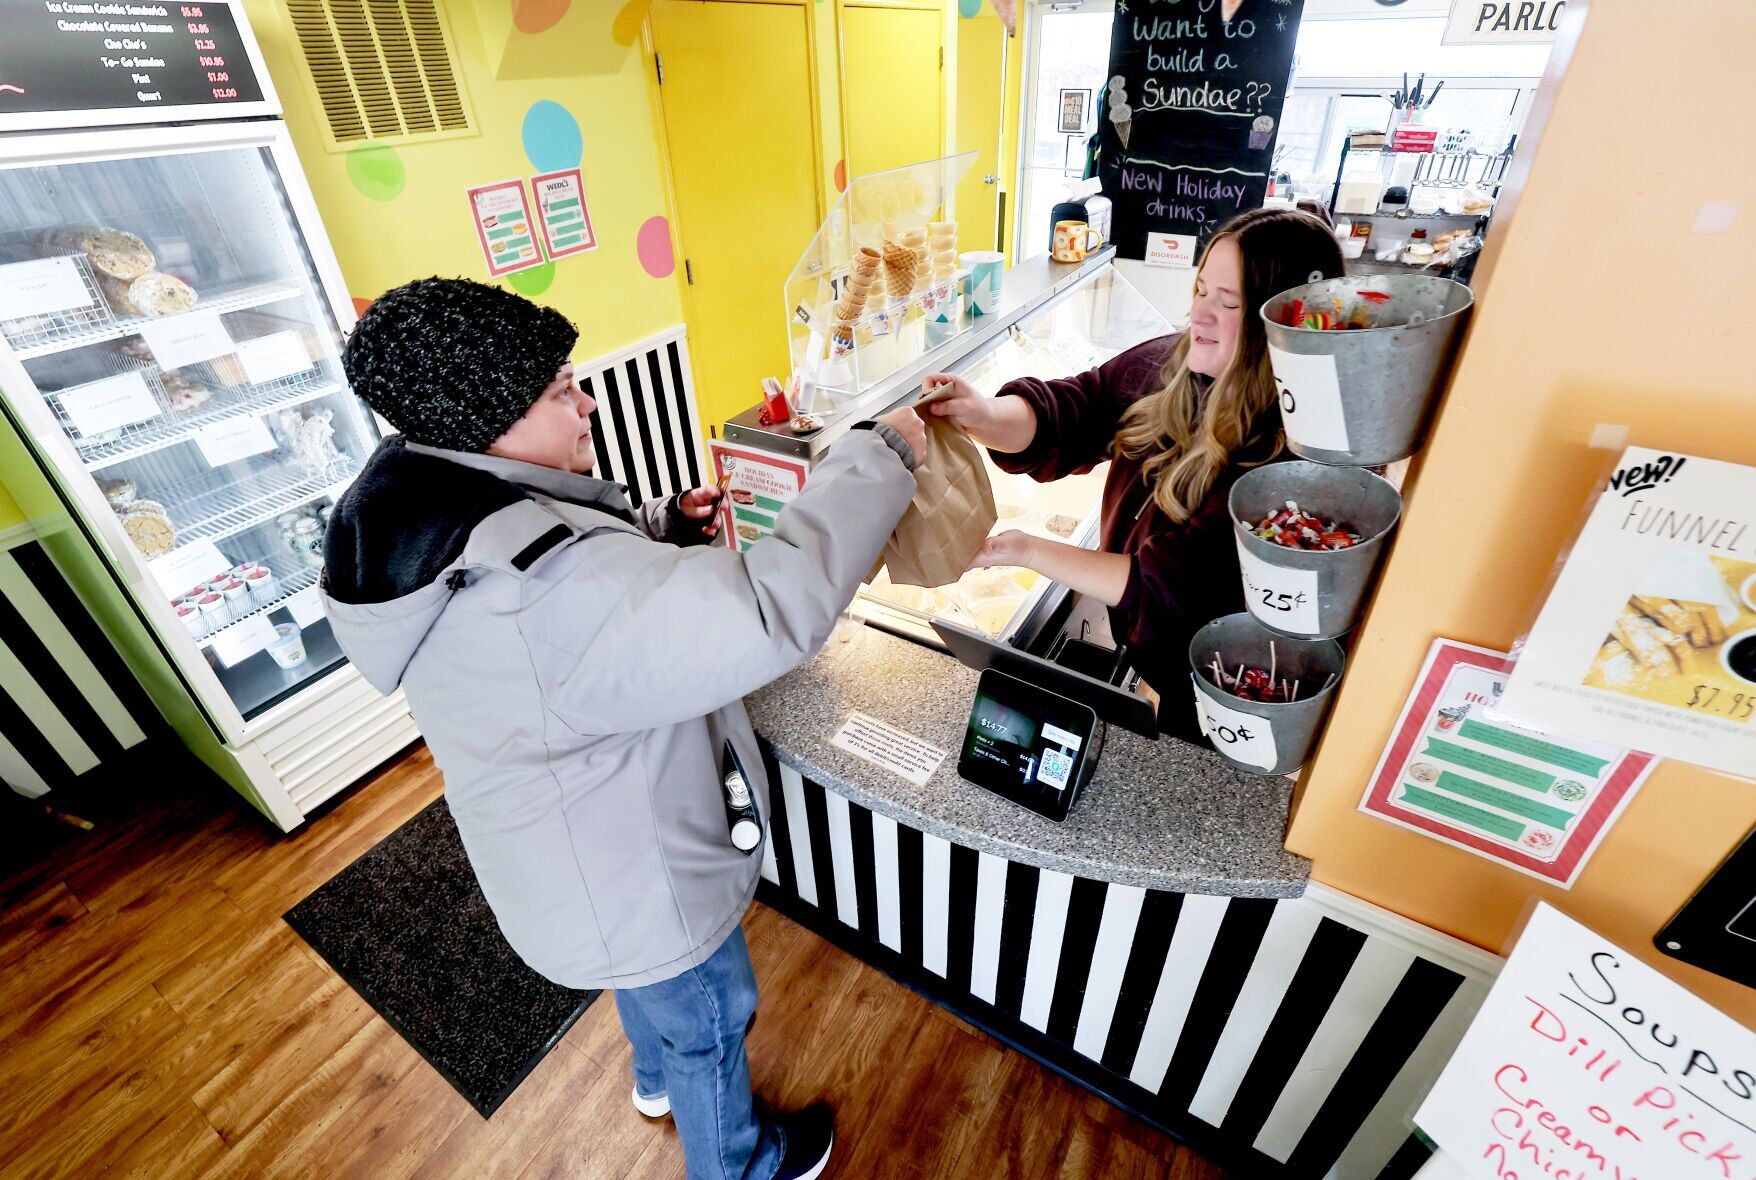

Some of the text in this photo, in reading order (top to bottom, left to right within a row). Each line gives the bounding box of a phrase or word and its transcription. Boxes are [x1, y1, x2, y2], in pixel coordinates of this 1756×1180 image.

[1133, 15, 1256, 41] Want to
[1147, 45, 1238, 73] build a
[1177, 174, 1246, 208] Holiday
[1147, 199, 1205, 223] drinks
[1151, 251, 1189, 260] DOORDASH
[1621, 499, 1748, 551] FUNNEL
[1686, 684, 1756, 718] $7.95
[980, 718, 1008, 735] $14.77
[1524, 995, 1621, 1082] Dill
[1587, 1105, 1642, 1142] or
